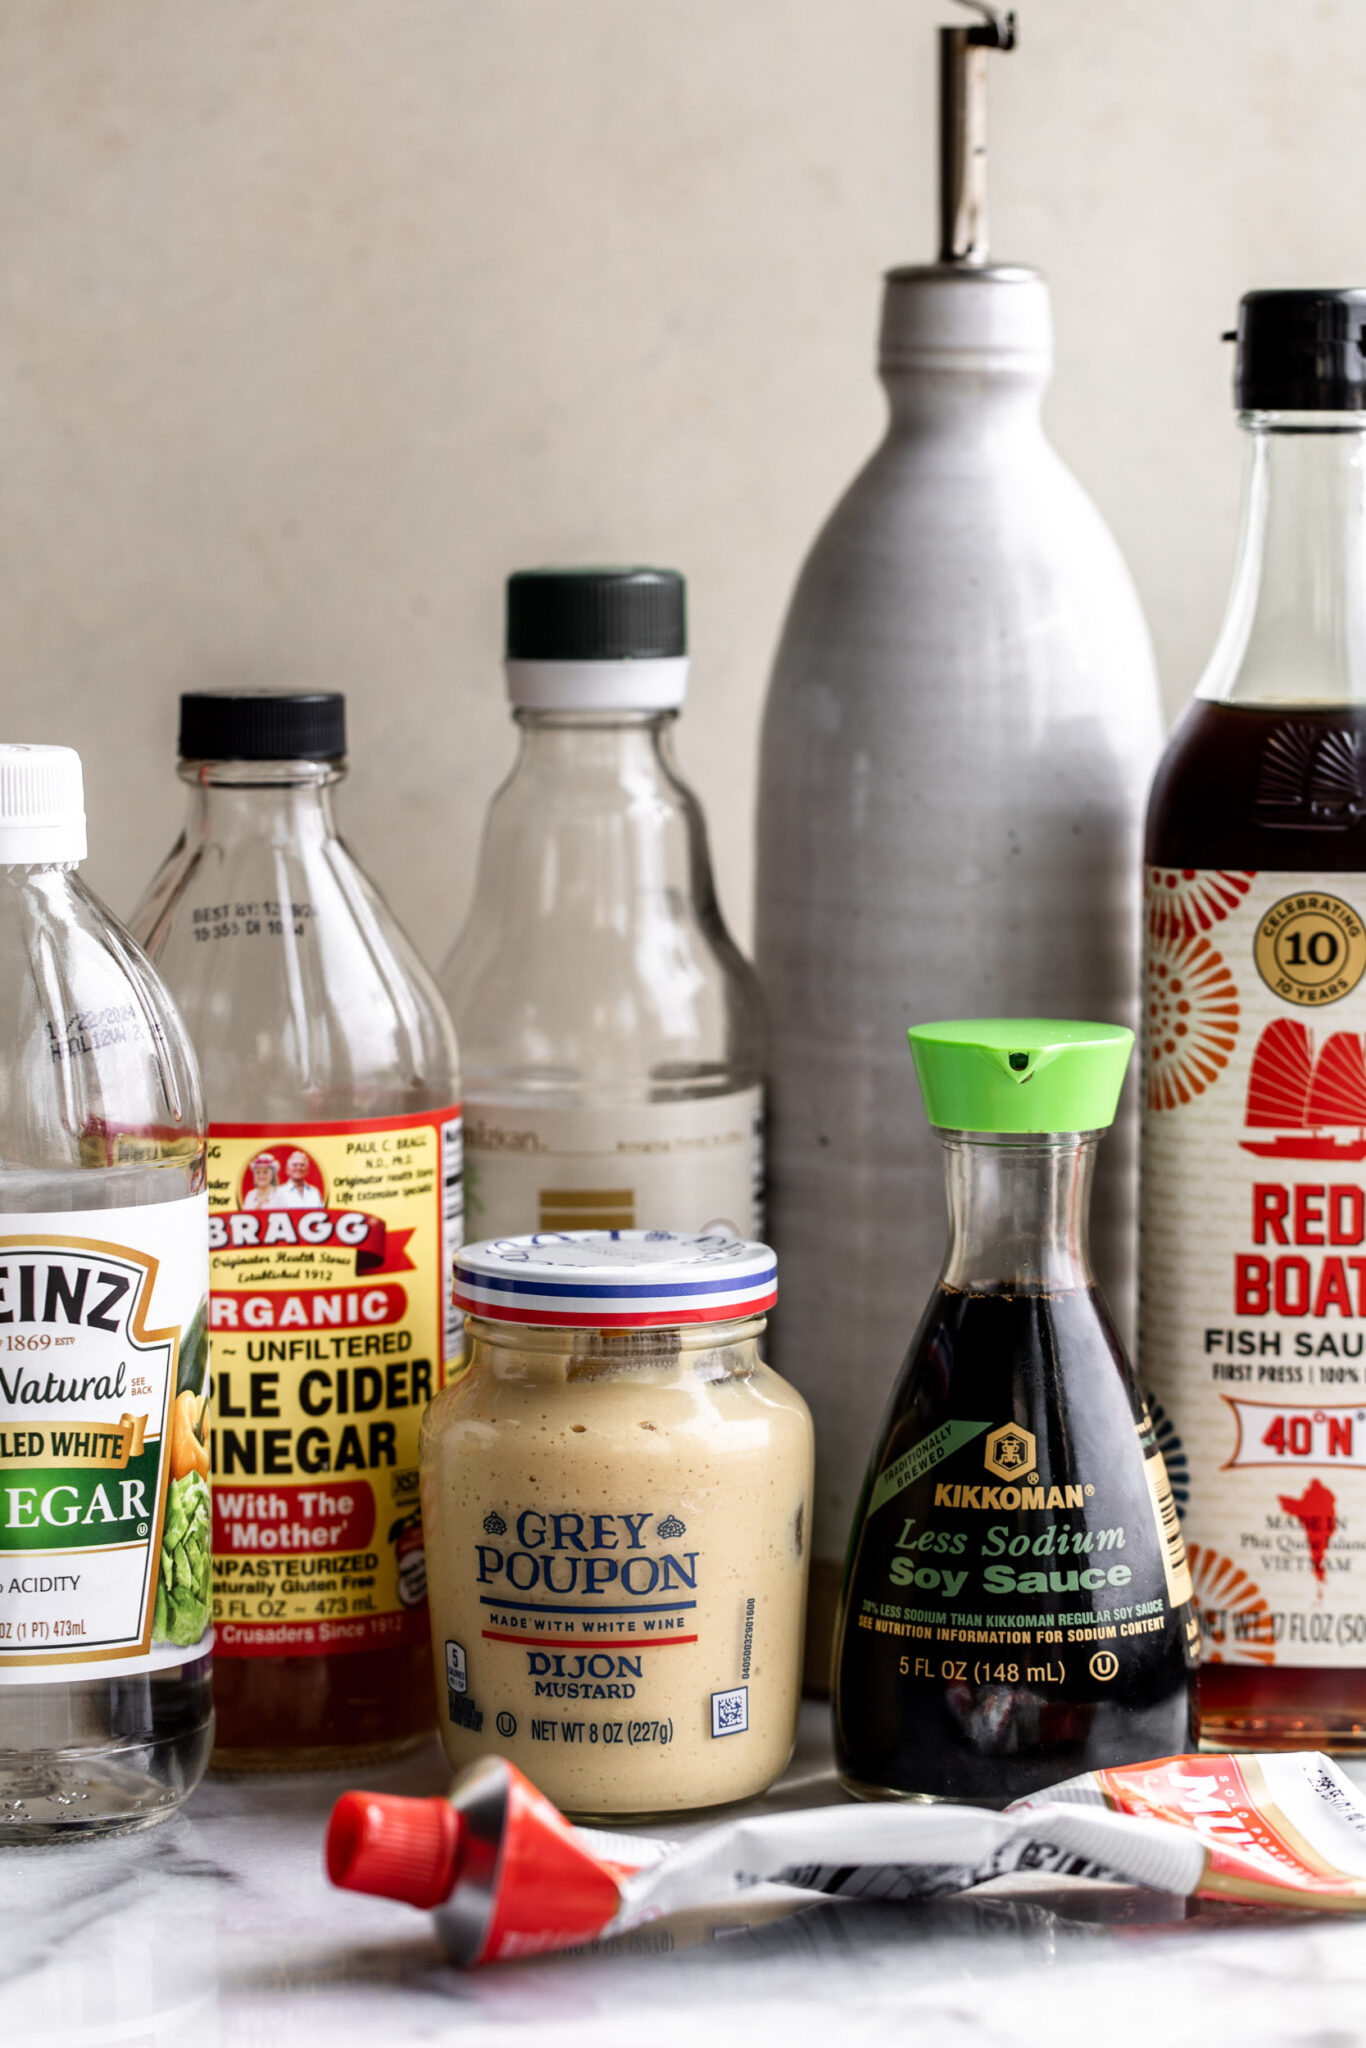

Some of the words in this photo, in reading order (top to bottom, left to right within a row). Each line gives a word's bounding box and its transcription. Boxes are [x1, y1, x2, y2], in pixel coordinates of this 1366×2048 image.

[193, 904, 229, 923] BEST
[1262, 897, 1361, 938] CELEBRATING
[1284, 931, 1338, 966] 10
[1275, 977, 1292, 994] 10
[1297, 978, 1349, 1001] YEARS
[346, 1142, 377, 1155] PAUL
[333, 1176, 383, 1188] Originator
[1252, 1182, 1365, 1246] RED
[209, 1211, 369, 1248] BRAGG
[212, 1255, 270, 1270] Originator
[305, 1269, 332, 1281] 1912
[1235, 1253, 1366, 1317] BOAT
[210, 1291, 388, 1327] RGANIC
[6, 1335, 51, 1351] 1869
[247, 1330, 411, 1362] UNFILTERED
[1204, 1328, 1281, 1355] FISH
[0, 1361, 127, 1405] Natural
[131, 1377, 146, 1387] SEE
[1212, 1363, 1252, 1381] FIRST
[1258, 1365, 1303, 1383] PRESS
[1319, 1366, 1359, 1383] 100%
[131, 1386, 153, 1396] BACK
[209, 1371, 280, 1418] LE
[299, 1358, 433, 1417] CIDER
[0, 1432, 45, 1457] LED
[51, 1432, 124, 1460] WHITE
[884, 1424, 952, 1484] TRADITIONALLY
[897, 1447, 945, 1488] BREWED
[4, 1480, 150, 1528] EGAR
[217, 1493, 287, 1519] With
[298, 1492, 354, 1518] The
[224, 1520, 348, 1548] 'Mother'
[516, 1511, 653, 1552] GREY
[895, 1518, 968, 1555] Less
[981, 1524, 1126, 1557] Sodium
[475, 1545, 700, 1595] POUPON
[889, 1557, 969, 1597] Soy
[982, 1564, 1132, 1594] Sauce
[8, 1575, 81, 1594] ACIDITY
[281, 1577, 336, 1594] Gluten
[341, 1575, 375, 1589] Free
[229, 1600, 252, 1618] FL
[258, 1600, 286, 1617] OZ
[315, 1598, 348, 1615] 473
[352, 1596, 378, 1611] mL
[880, 1603, 901, 1619] LESS
[904, 1608, 947, 1624] SODIUM
[950, 1613, 982, 1626] THAN
[986, 1614, 1055, 1628] KIKKOMAN
[1058, 1611, 1111, 1626] REGULAR
[1114, 1606, 1133, 1621] SOY
[1135, 1599, 1164, 1617] SAUCE
[32, 1621, 49, 1641] PT)
[53, 1619, 87, 1637] 473mL
[222, 1625, 314, 1645] Crusaders
[318, 1622, 365, 1642] Since
[371, 1616, 403, 1633] 1912
[490, 1613, 528, 1629] MADE
[534, 1620, 575, 1632] WITH
[582, 1621, 636, 1633] WHITE
[643, 1617, 685, 1632] WINE
[858, 1614, 873, 1630] SEE
[875, 1619, 932, 1639] NUTRITION
[936, 1628, 1031, 1645] INFORMATION
[1036, 1631, 1063, 1644] FOR
[1067, 1625, 1117, 1642] SODIUM
[1120, 1616, 1165, 1635] CONTENT
[1290, 1612, 1308, 1641] FL
[1310, 1612, 1332, 1642] OZ
[452, 1648, 459, 1668] 5
[526, 1652, 643, 1679] DIJON
[899, 1656, 909, 1675] 5
[915, 1658, 935, 1678] FL
[941, 1660, 967, 1680] OZ
[974, 1661, 1019, 1685] (148
[1026, 1660, 1065, 1685] mL)
[534, 1681, 636, 1700] MUSTARD
[531, 1719, 558, 1742] NET
[561, 1722, 585, 1743] WT
[589, 1723, 599, 1743] 8
[603, 1722, 623, 1743] OZ
[627, 1718, 674, 1745] (227g)
